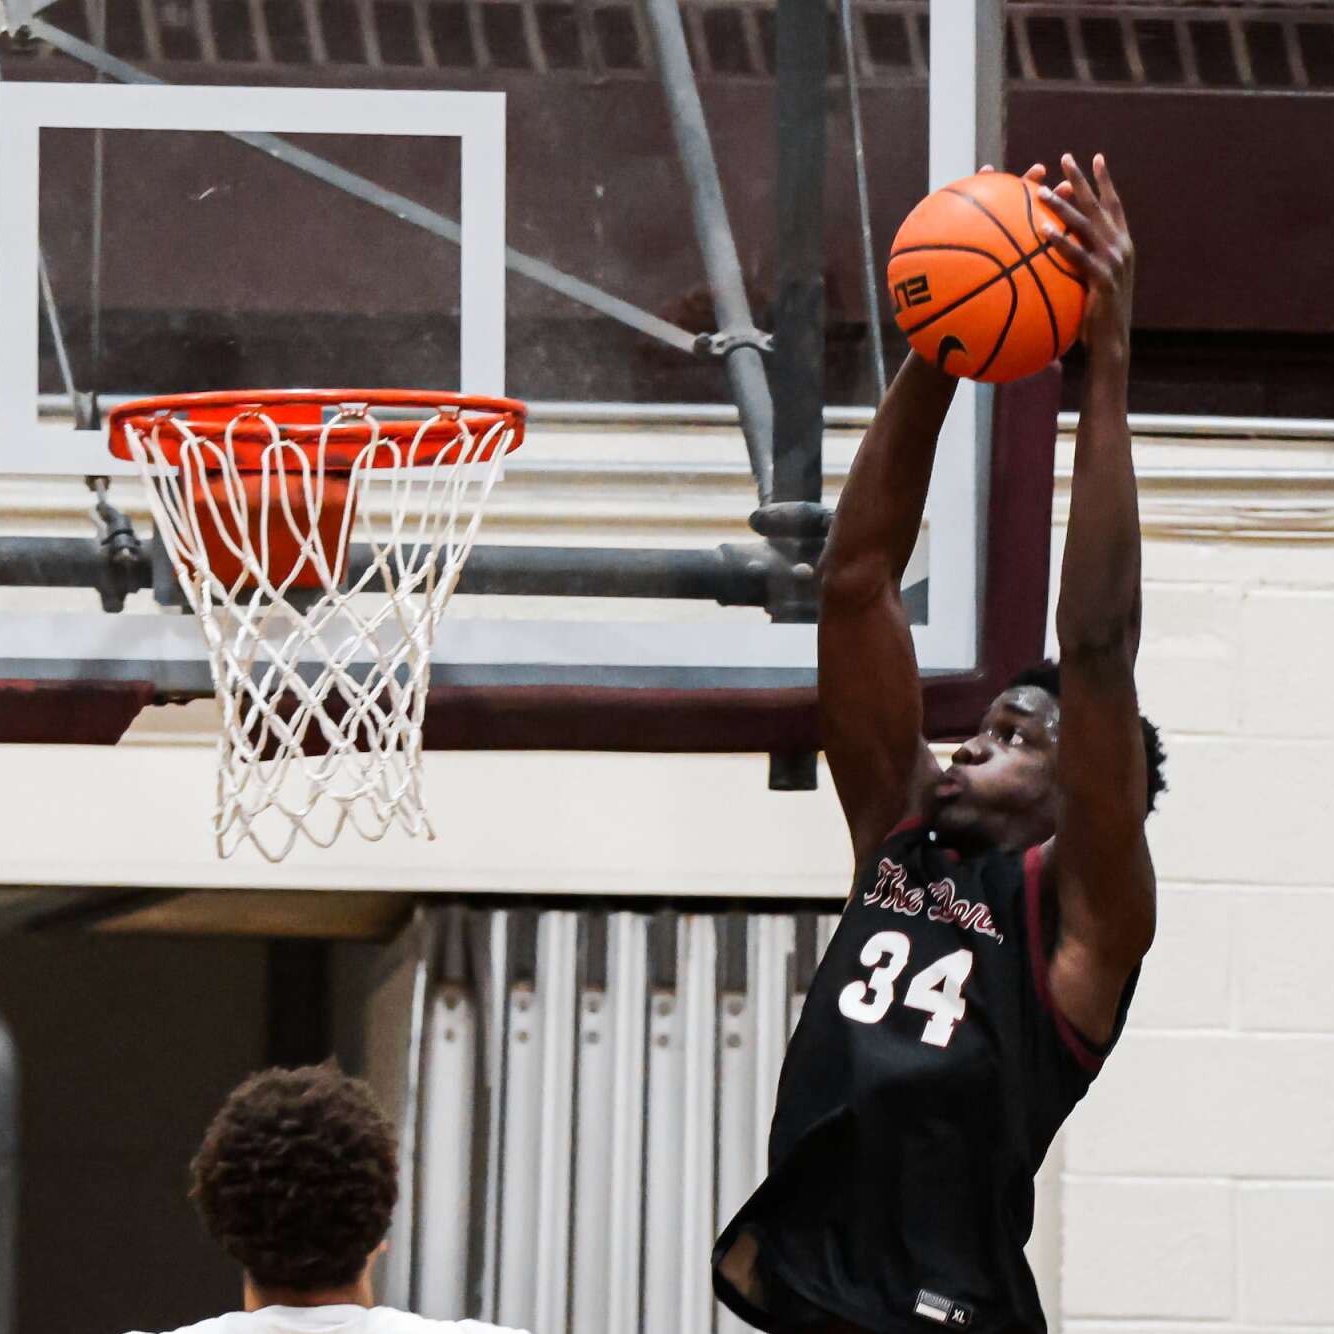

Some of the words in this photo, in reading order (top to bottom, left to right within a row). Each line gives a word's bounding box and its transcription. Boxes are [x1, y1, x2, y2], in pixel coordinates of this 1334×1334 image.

[863, 857, 925, 916] The
[838, 930, 974, 1048] 34
[952, 1308, 966, 1324] XL
